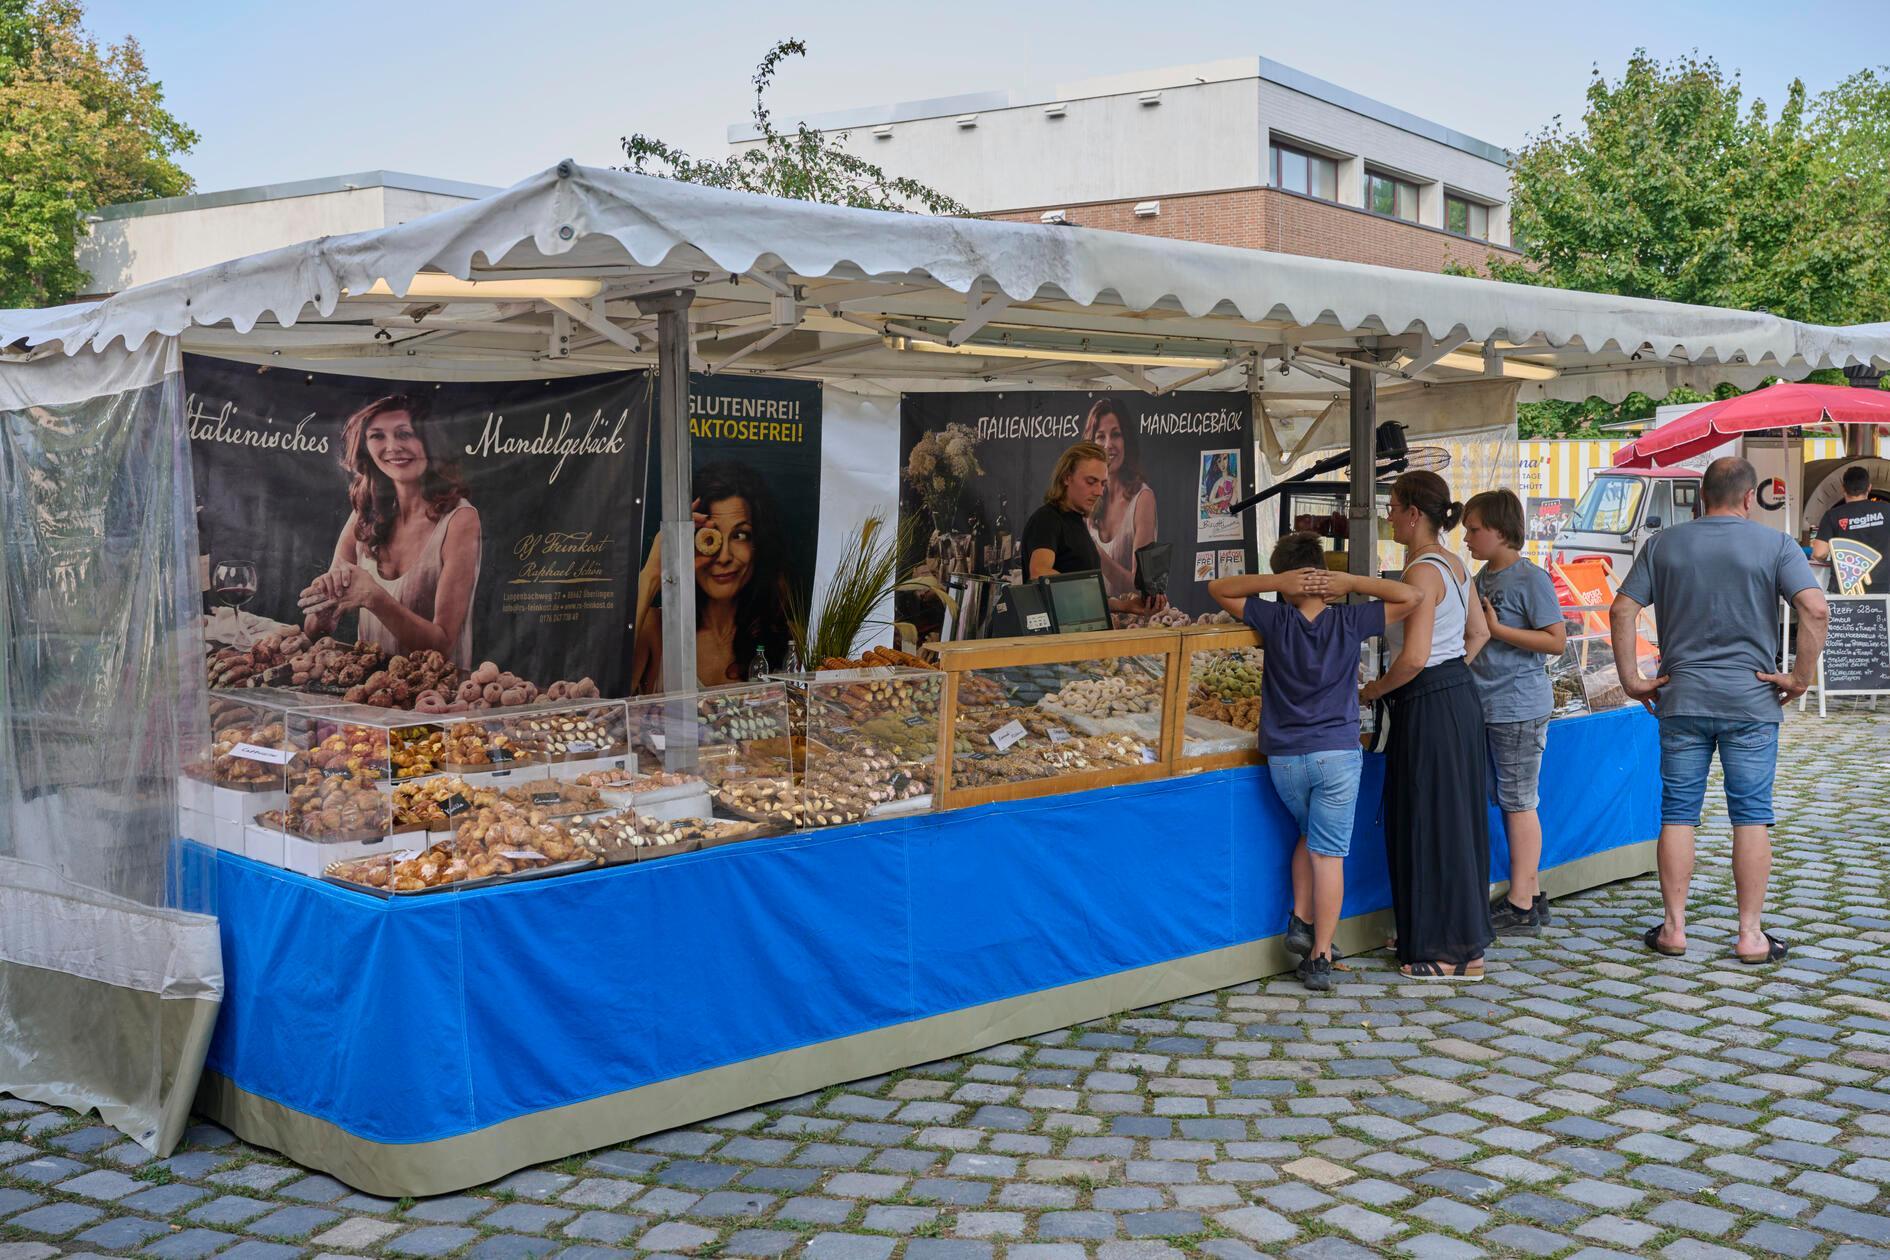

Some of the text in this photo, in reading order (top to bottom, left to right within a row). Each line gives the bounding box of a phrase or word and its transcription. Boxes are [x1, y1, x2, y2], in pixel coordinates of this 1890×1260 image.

[688, 394, 800, 420] GLUTENFREI!
[690, 418, 804, 442] AKTOSEFREI!
[978, 408, 1242, 440] ITALIENISCHES MANDELGEBÄCK
[465, 408, 629, 485] Mandelgebäck
[1518, 482, 1543, 490] CHÜTT
[1849, 512, 1884, 525] regiNA
[541, 531, 615, 554] Feinkost
[520, 560, 576, 583] Raphael
